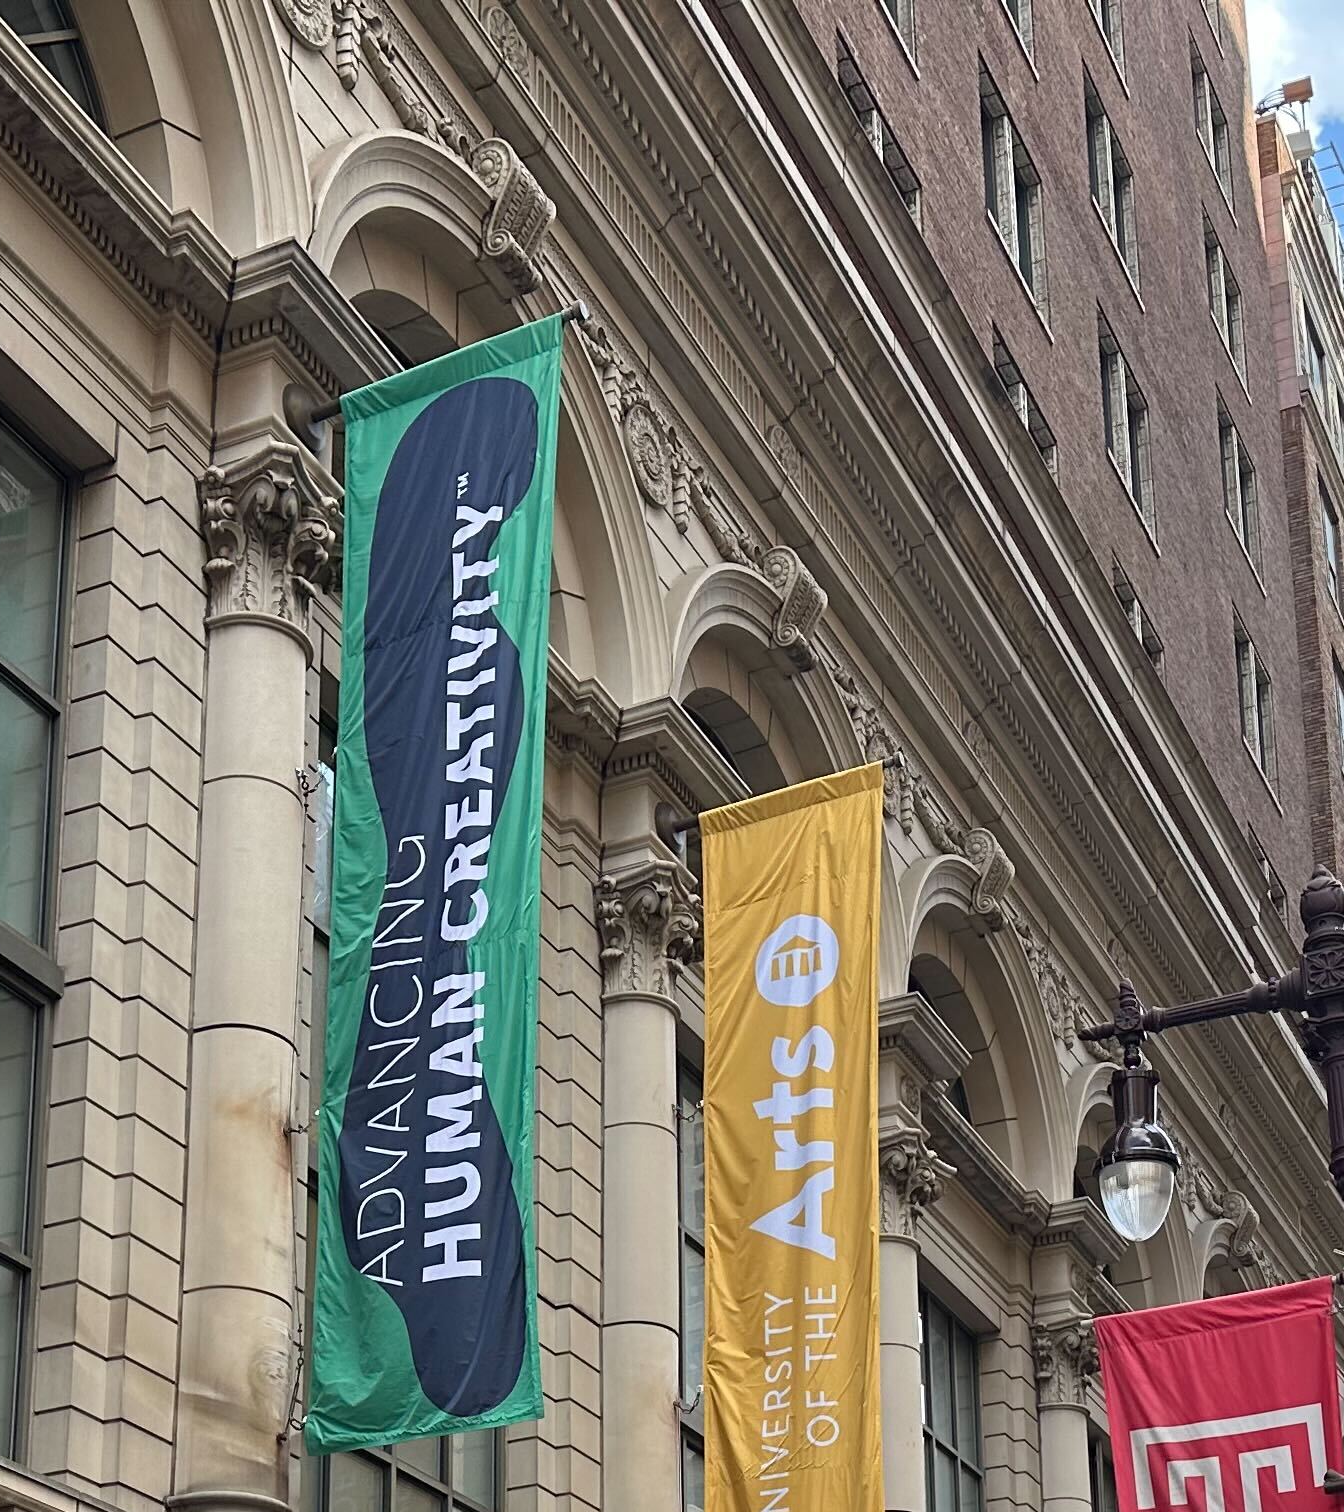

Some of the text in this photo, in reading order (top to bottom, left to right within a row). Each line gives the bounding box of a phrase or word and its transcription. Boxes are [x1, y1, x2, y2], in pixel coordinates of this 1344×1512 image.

[359, 833, 428, 1287] ADVANCING
[422, 970, 487, 1284] HUMAN
[749, 1024, 837, 1261] Arts
[805, 1283, 839, 1448] OF THE
